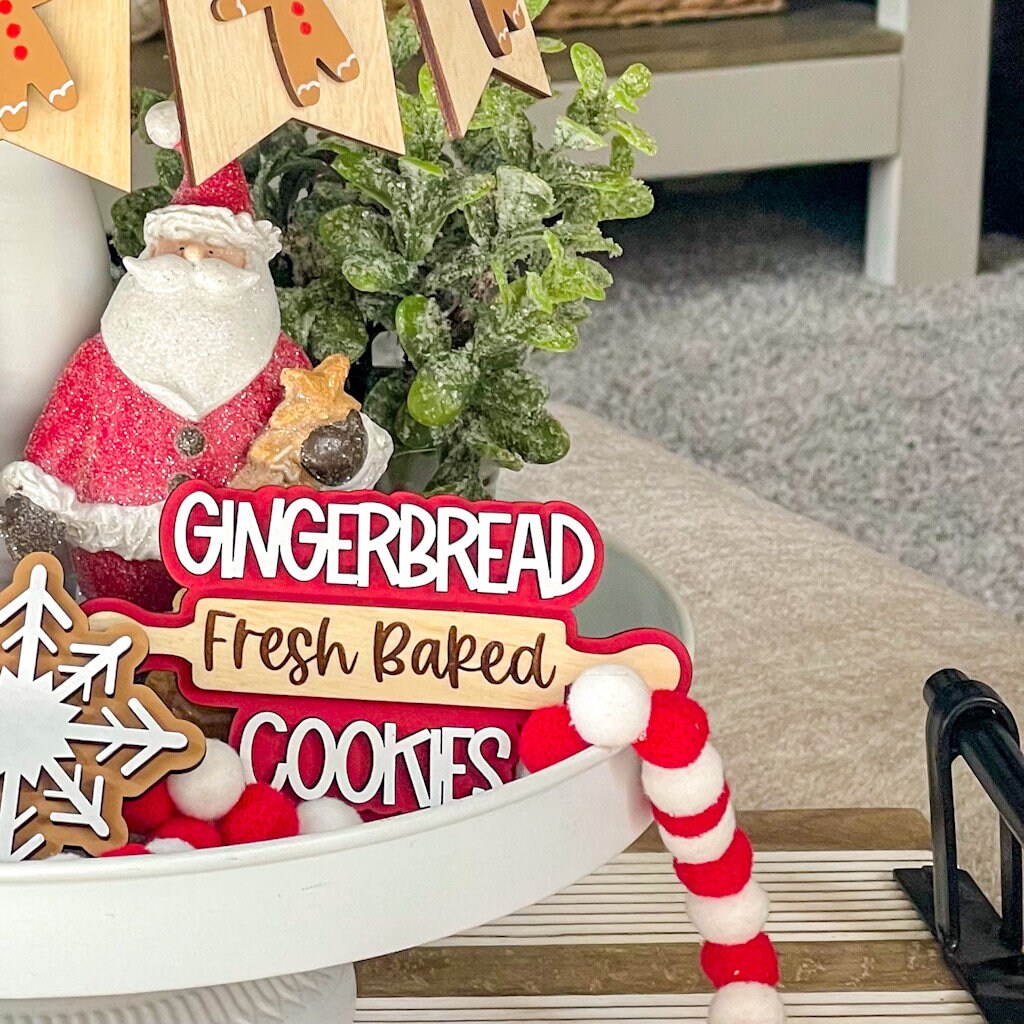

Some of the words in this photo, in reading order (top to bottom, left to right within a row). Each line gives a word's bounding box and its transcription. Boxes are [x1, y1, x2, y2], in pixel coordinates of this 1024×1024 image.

[175, 491, 596, 599] GINGERBREAD
[204, 610, 359, 686] Fresh
[373, 621, 557, 689] Baked
[240, 711, 511, 808] COOKIES
